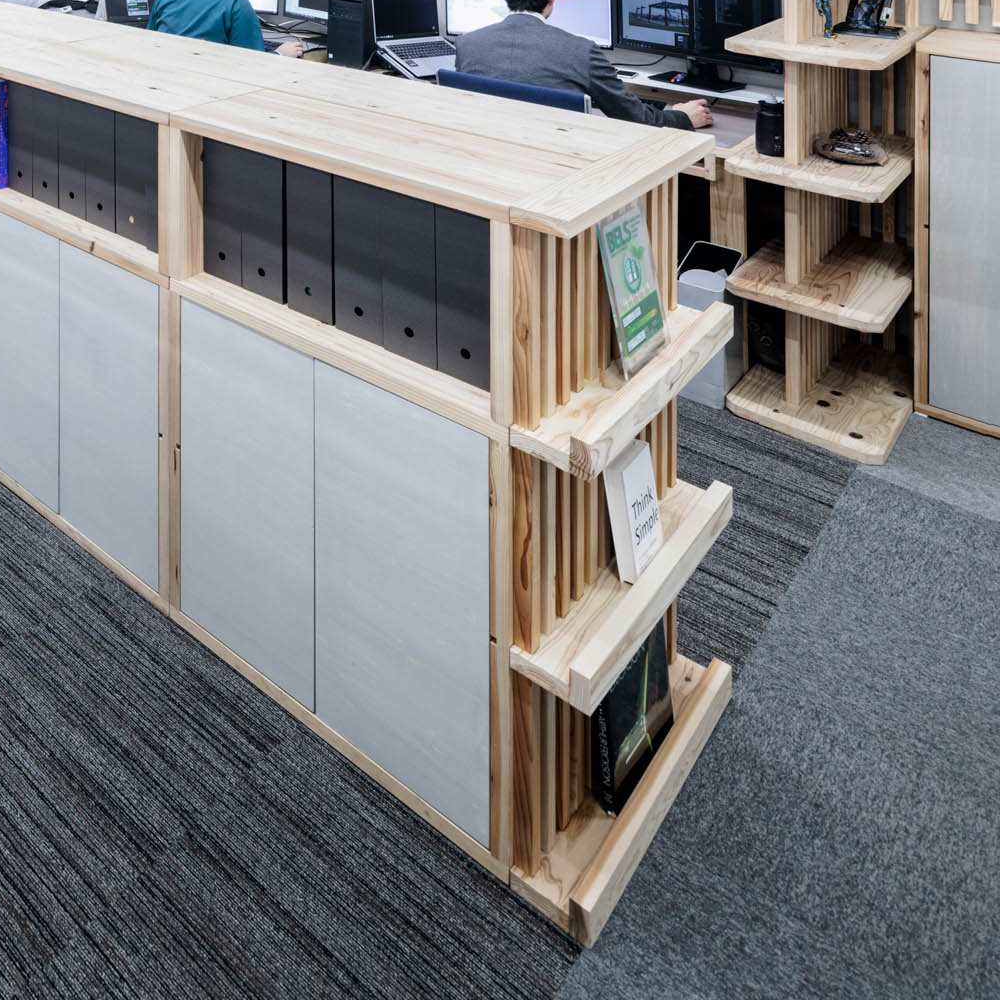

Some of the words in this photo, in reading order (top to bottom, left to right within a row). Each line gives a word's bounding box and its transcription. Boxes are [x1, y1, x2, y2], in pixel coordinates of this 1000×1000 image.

[606, 220, 632, 253] BELS
[631, 485, 654, 520] Think
[635, 507, 659, 545] Simple
